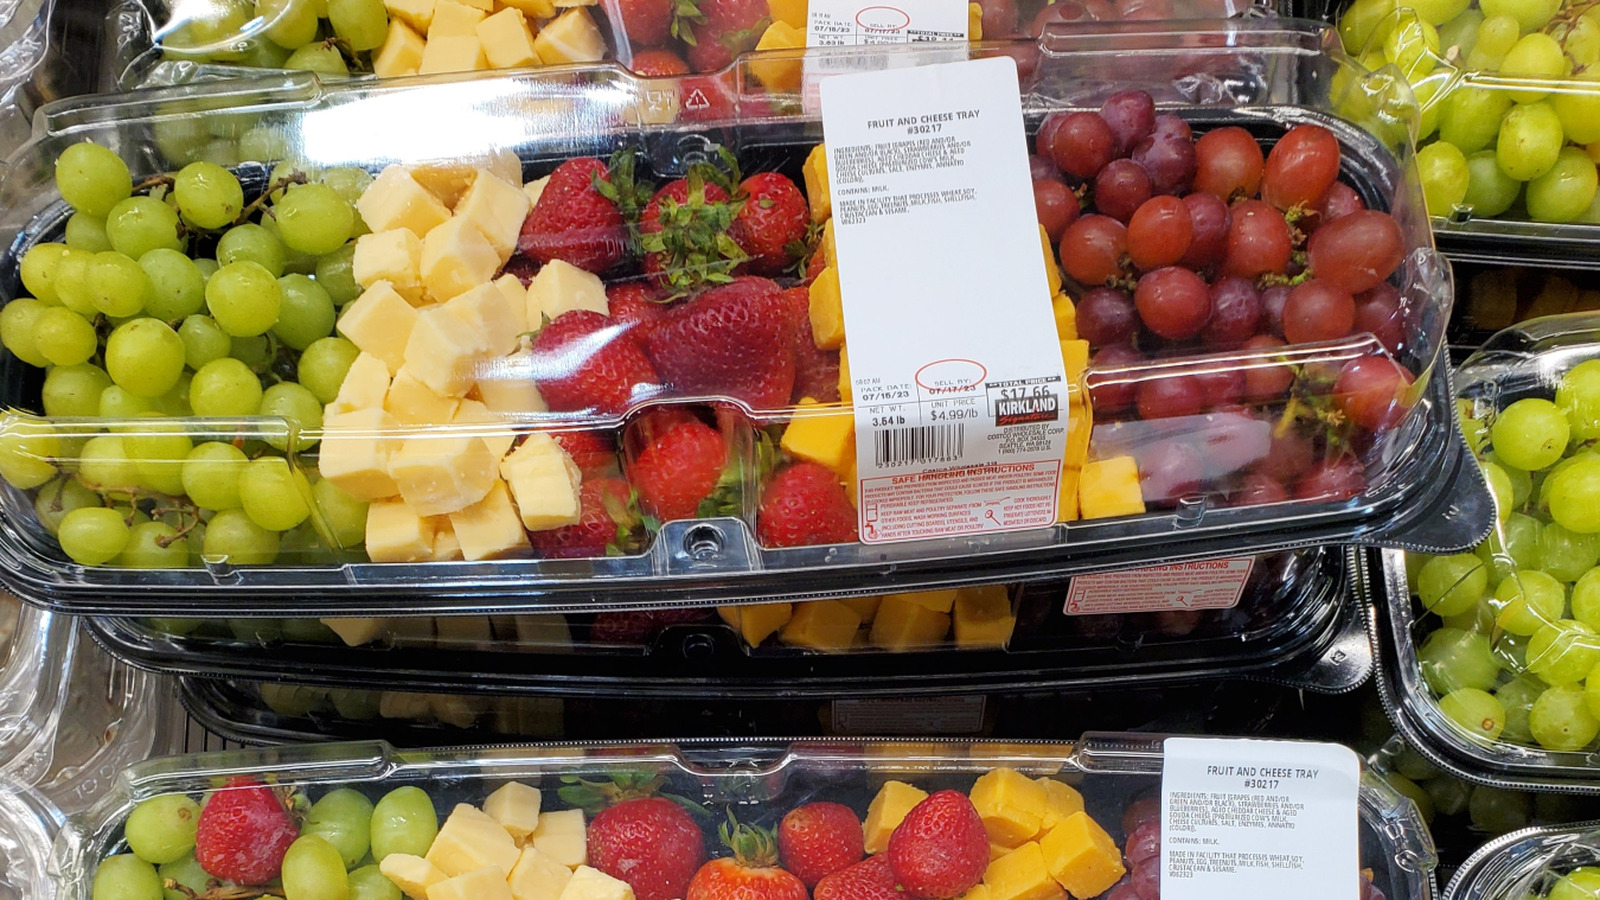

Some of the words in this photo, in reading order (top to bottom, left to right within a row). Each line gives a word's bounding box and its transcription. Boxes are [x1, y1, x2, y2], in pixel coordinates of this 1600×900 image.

[867, 118, 894, 129] FRUIT
[897, 116, 917, 126] AND
[920, 112, 953, 124] CHEESE
[956, 109, 980, 120] TRAY
[907, 124, 942, 134] #30217
[1000, 385, 1050, 399] $1766
[998, 398, 1056, 416] KIRKLAND
[896, 416, 905, 424] lb
[931, 408, 978, 421] $4.99/lb
[999, 412, 1050, 425] Signature
[892, 476, 916, 484] SAFE
[918, 470, 965, 482] HANDLING
[967, 464, 1035, 476] INSTRUCTIONS
[1170, 562, 1229, 571] INSTRUCTIONS
[1207, 766, 1234, 775] FRUIT
[1236, 767, 1256, 776] AND
[1259, 768, 1292, 778] CHEESE
[1295, 769, 1319, 778] TRAY
[1244, 779, 1279, 789] #30217
